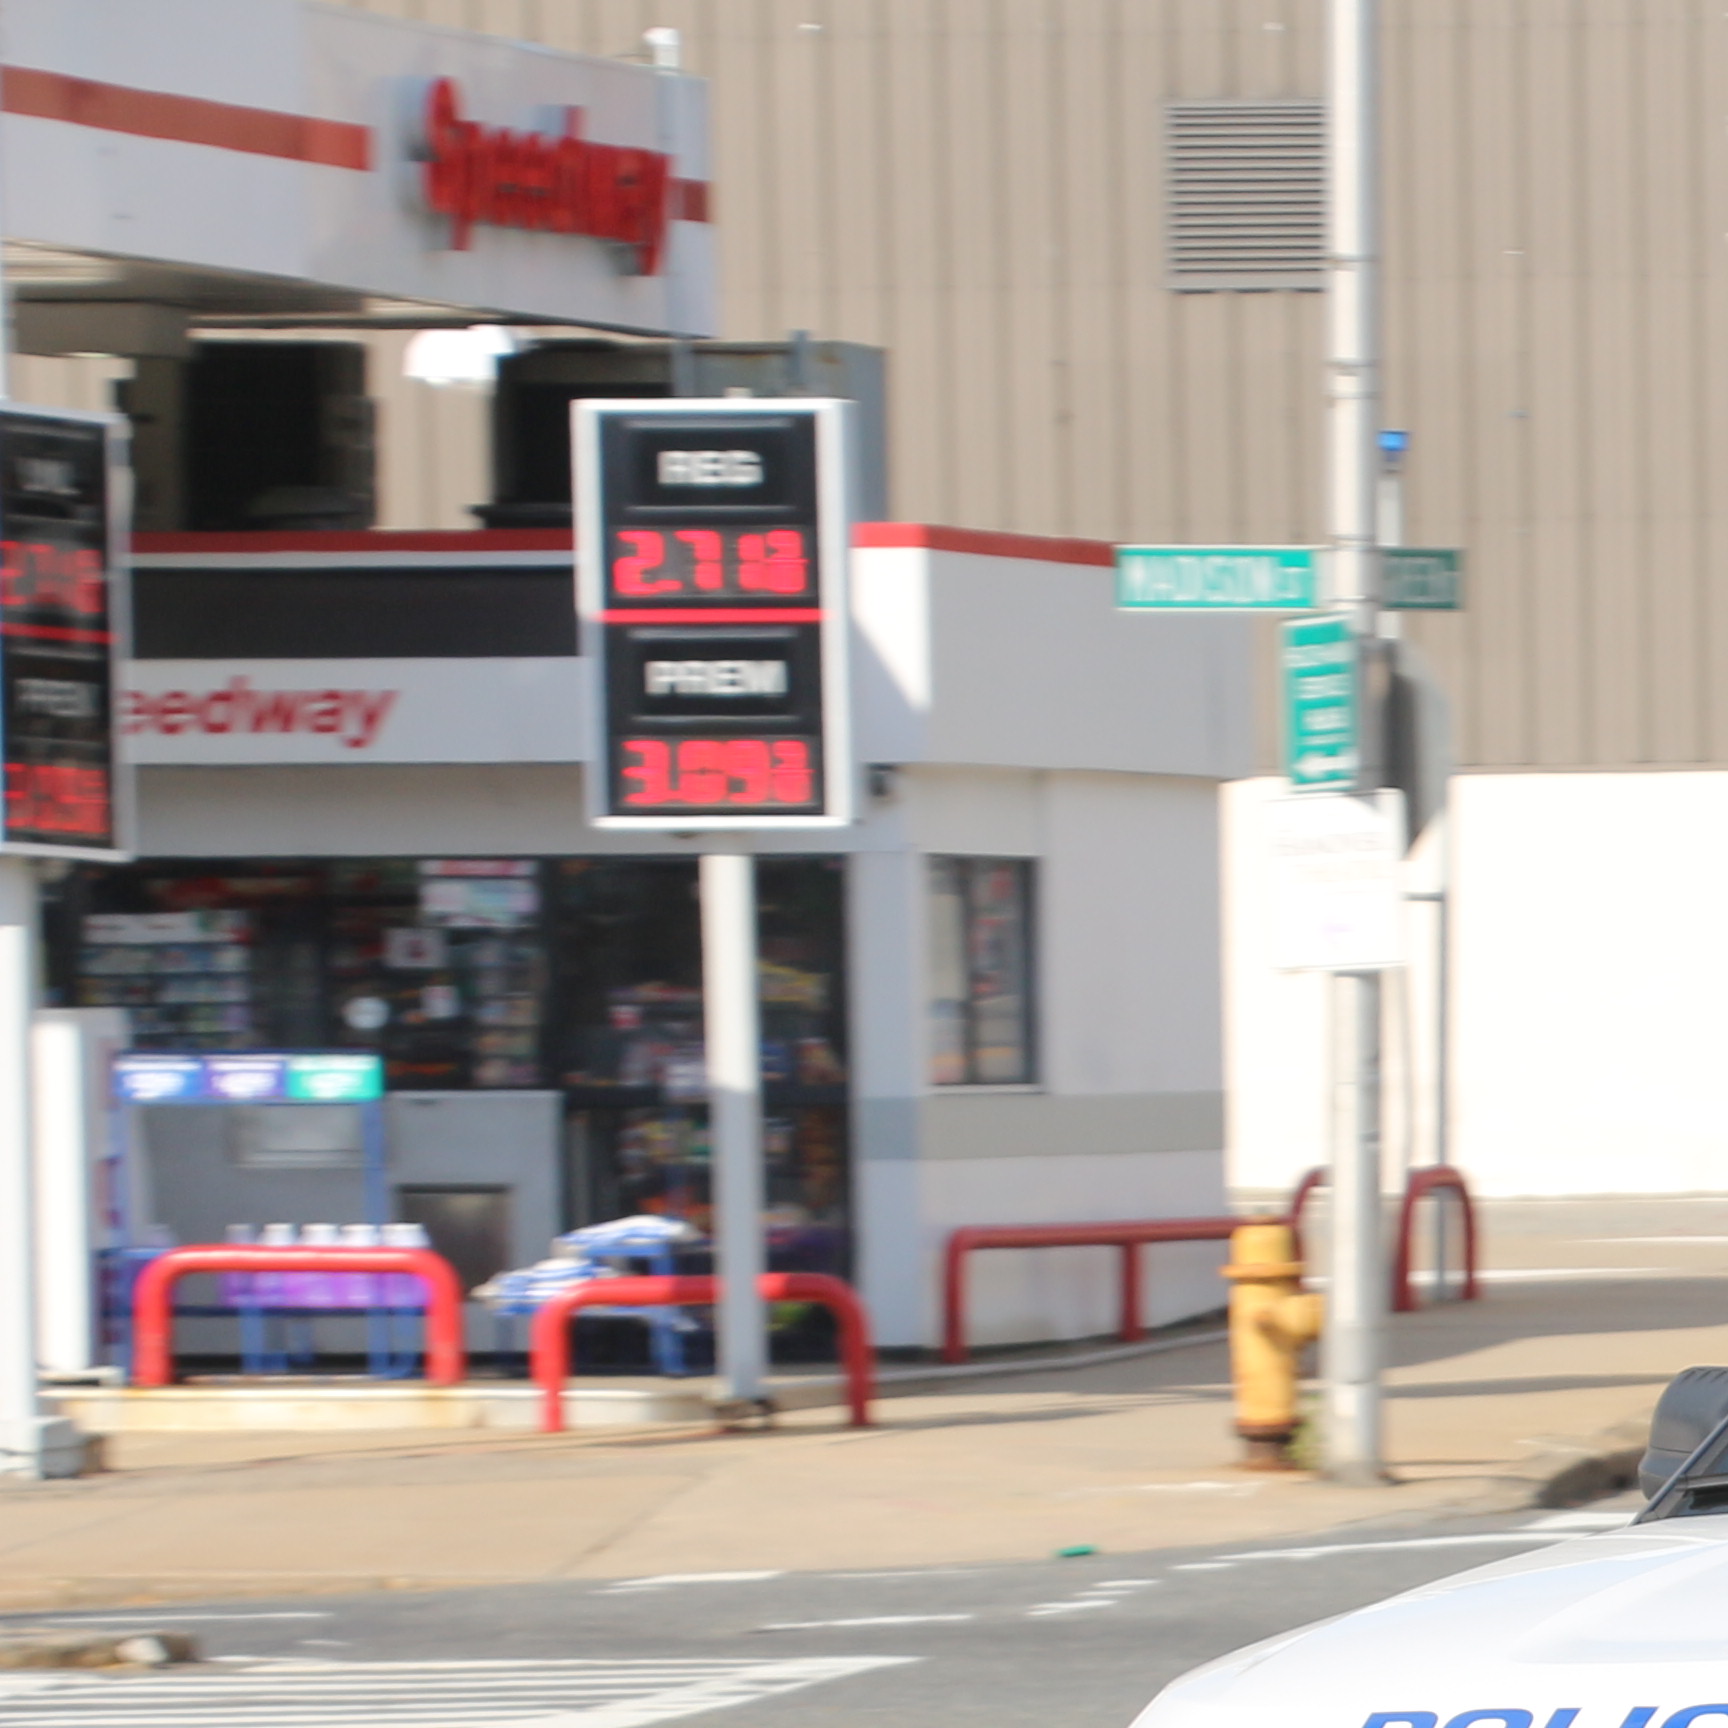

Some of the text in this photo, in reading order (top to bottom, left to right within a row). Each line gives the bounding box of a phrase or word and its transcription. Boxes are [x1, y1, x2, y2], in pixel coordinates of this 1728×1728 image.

[656, 450, 764, 486] REG
[644, 660, 788, 696] PREM
[119, 674, 400, 748] eedway
